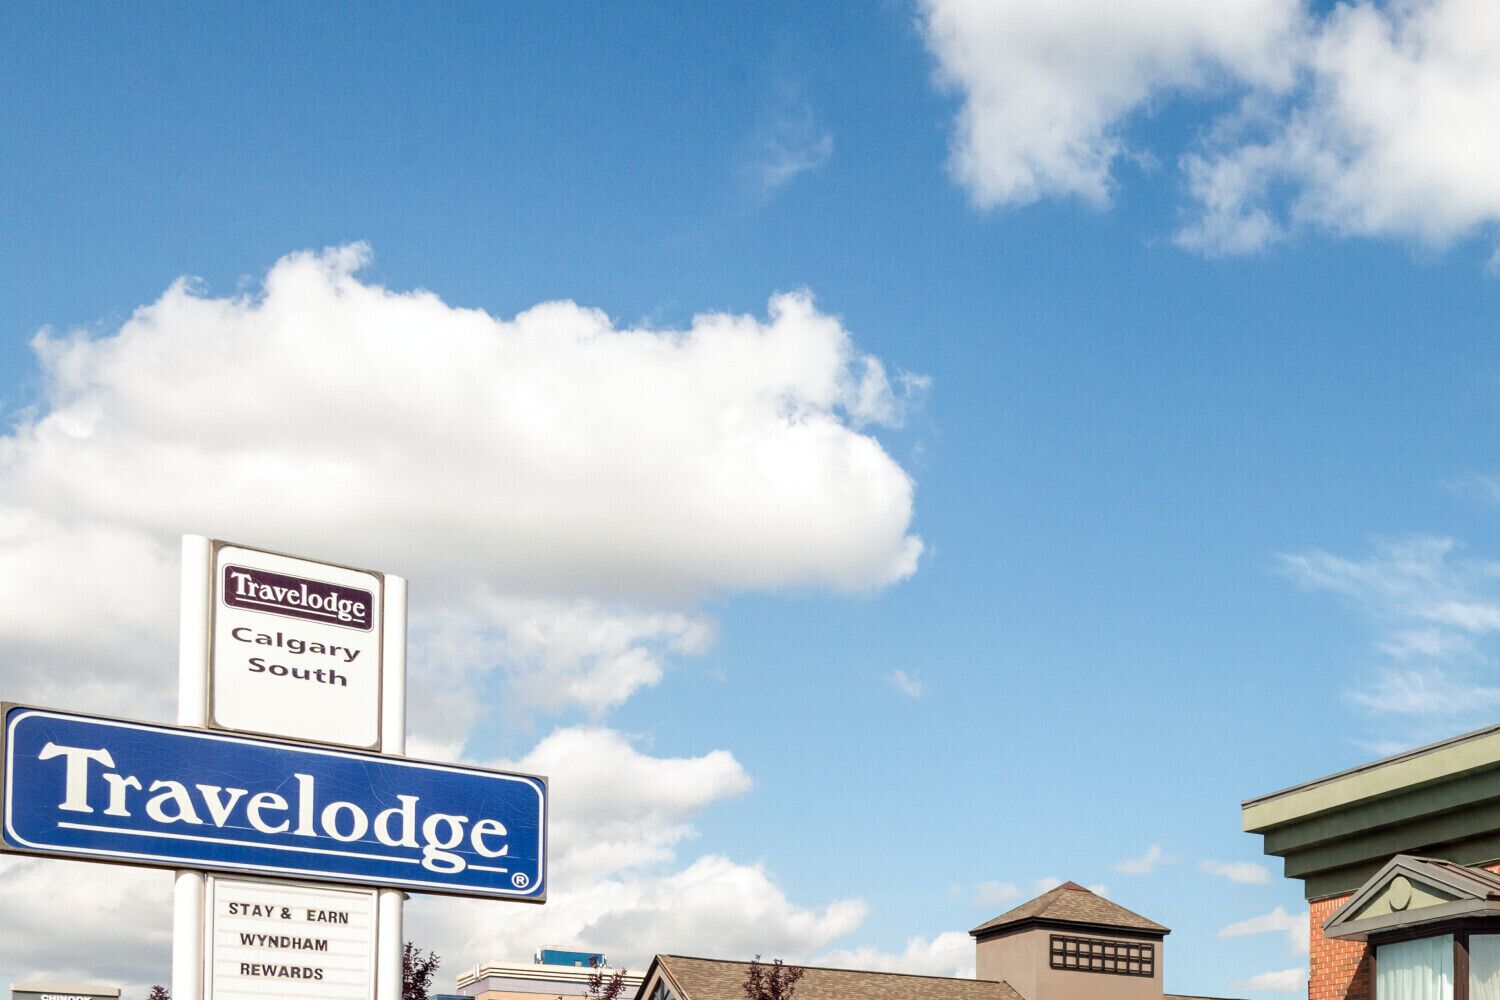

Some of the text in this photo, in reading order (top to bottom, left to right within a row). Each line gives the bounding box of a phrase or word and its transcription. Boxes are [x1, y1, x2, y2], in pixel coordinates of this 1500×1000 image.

[231, 571, 366, 622] Travelodge
[231, 627, 361, 663] Calgary
[248, 657, 348, 687] South
[38, 741, 509, 875] Travelodge
[229, 902, 350, 924] STAY & EARN
[240, 933, 329, 952] WYNDHAM
[240, 963, 324, 980] REWARDS
